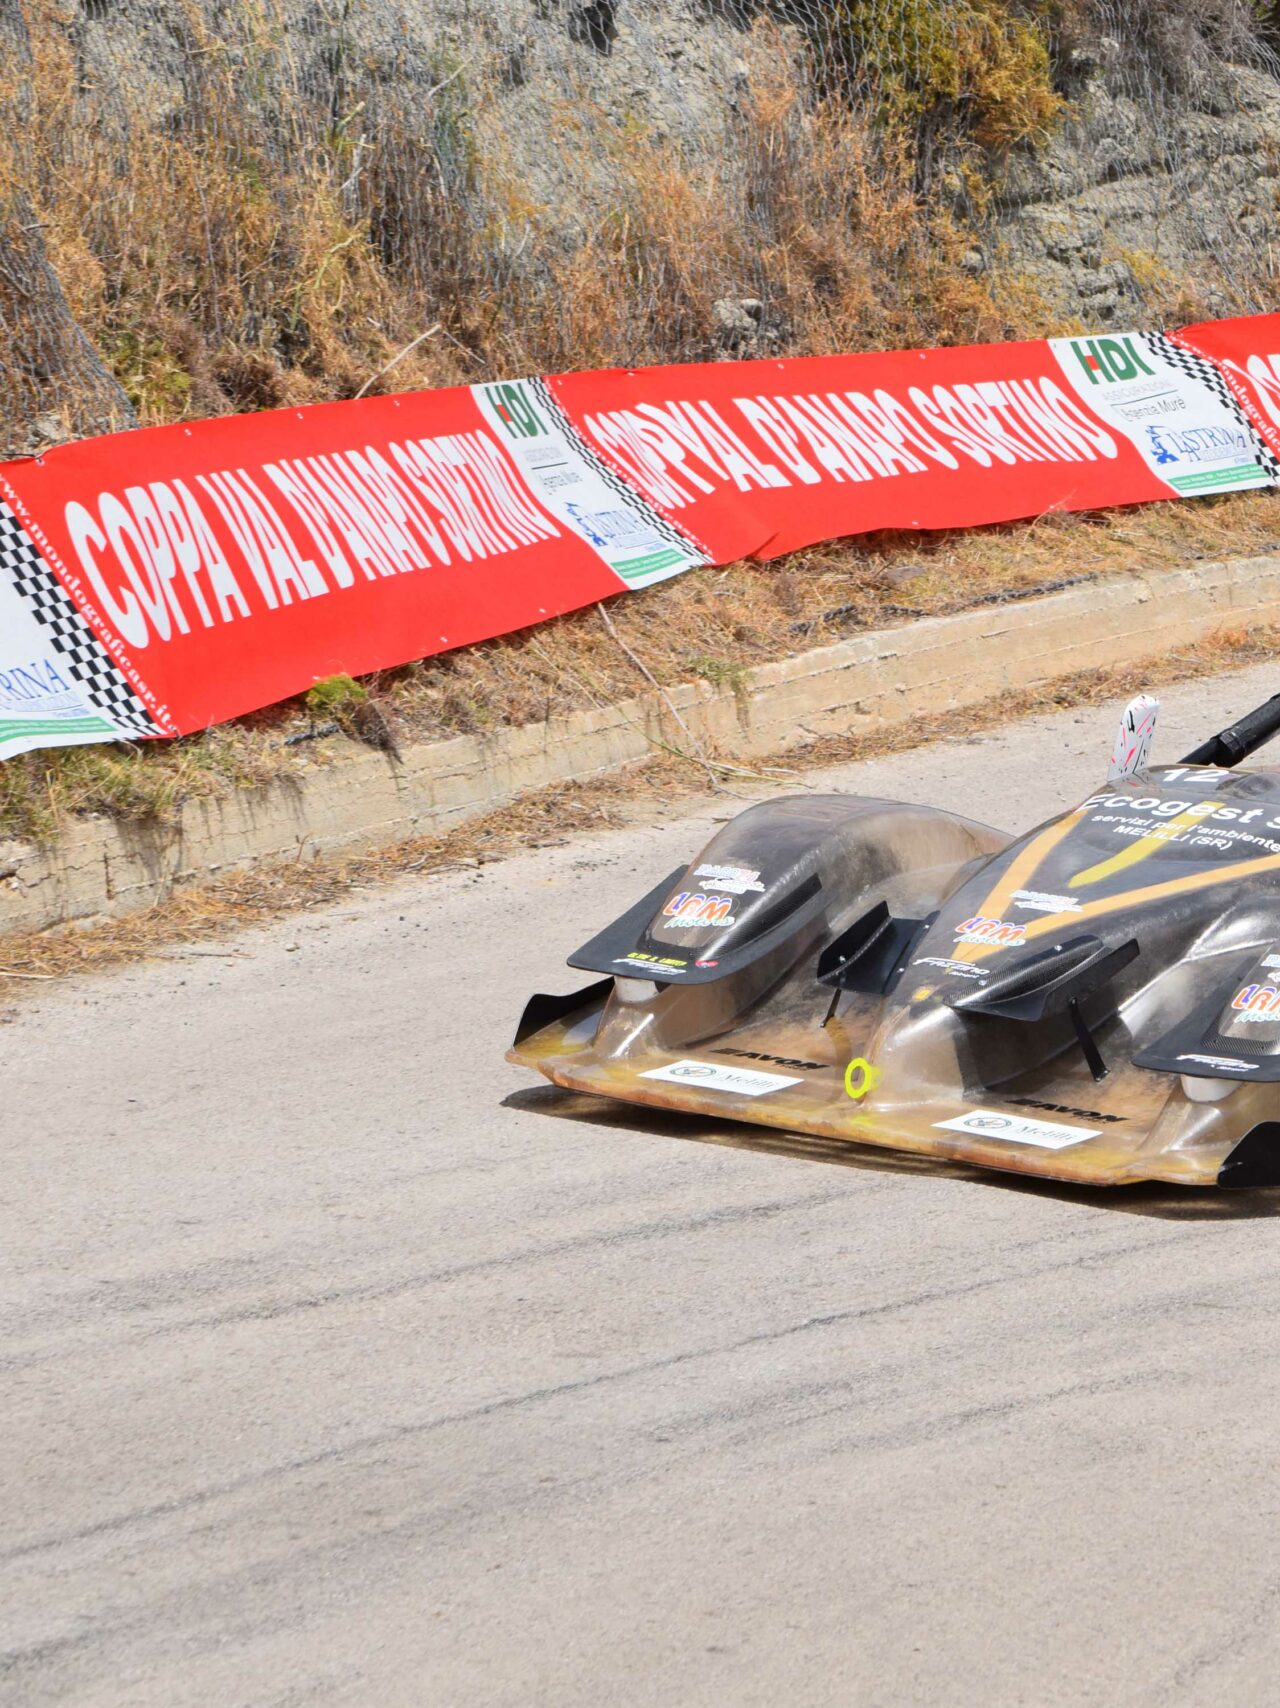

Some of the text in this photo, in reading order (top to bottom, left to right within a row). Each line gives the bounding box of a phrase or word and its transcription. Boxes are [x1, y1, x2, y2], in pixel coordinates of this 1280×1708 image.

[1070, 337, 1156, 384] HDI
[484, 382, 549, 439] HDI
[732, 388, 959, 484] D'ANAPO
[908, 376, 1118, 467] SORTINO
[262, 445, 452, 590] D'ANAPO
[388, 429, 562, 562] SORTINO
[196, 468, 330, 610] VAL
[65, 478, 251, 649] COPPA
[1162, 767, 1230, 783] 12
[1074, 793, 1264, 824] Ecogest
[1091, 813, 1151, 828] servizi
[1153, 819, 1183, 834] per
[1112, 825, 1233, 851] MELILLI (SR)
[732, 1051, 831, 1070] AVON
[1030, 1103, 1131, 1123] AVON
